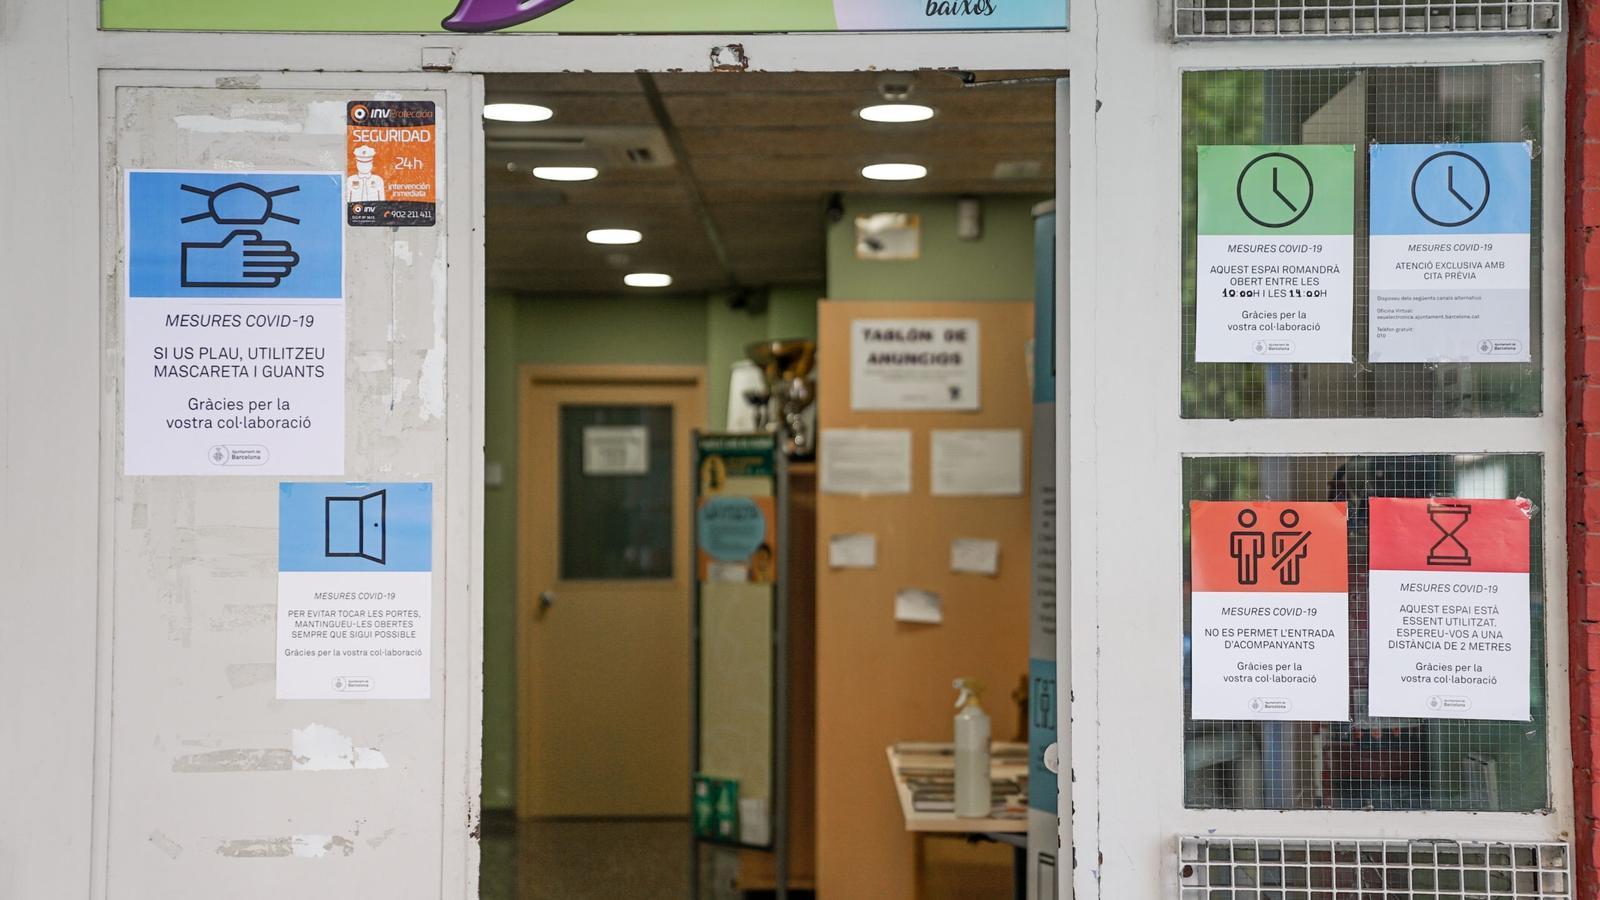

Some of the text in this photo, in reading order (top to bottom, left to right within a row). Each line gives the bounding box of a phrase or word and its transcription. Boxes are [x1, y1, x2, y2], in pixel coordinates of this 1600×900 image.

[925, 0, 996, 16] baixos
[352, 129, 431, 142] SEGURIDAD
[388, 182, 431, 190] intervención
[392, 189, 426, 197] inmediata
[391, 210, 432, 218] 902 211 411
[1227, 244, 1323, 253] MESURES COVID-19
[1408, 244, 1452, 252] MESURES
[1210, 264, 1340, 274] AQUEST ESPAI ROMANDRÀ
[1395, 261, 1505, 270] ATENCIÓ EXCLUSIVA AMB
[1423, 272, 1443, 280] CITA
[1230, 277, 1320, 286] OBERT ENTRE LES
[1268, 289, 1287, 298] LES
[1242, 310, 1307, 321] Gràcies per la
[165, 314, 314, 328] MESURES COVID-19
[1227, 323, 1257, 331] vostra
[862, 327, 968, 343] TABLÓN DE
[153, 346, 325, 361] SI US PLAU, UTILITZEU
[867, 351, 962, 366] ANUNCIOS
[154, 365, 249, 378] MASCARETA
[262, 365, 324, 378] GUANTS
[188, 397, 290, 413] Gràcies per la
[166, 417, 213, 429] vostra
[1400, 583, 1498, 594] MESURES COVID-19
[314, 592, 396, 600] MESURES COVID-19
[288, 610, 305, 618] PER
[307, 610, 336, 618] EVITAR
[338, 610, 366, 618] TOCAR
[367, 610, 383, 618] LES
[1221, 607, 1317, 617] MESURES COVID-19
[1399, 604, 1499, 615] AQUEST ESPAI ESTÀ
[294, 620, 413, 628] MANTINGUEU-LES OBERTES
[1403, 617, 1497, 627] ESSENT UTILITZAT.
[291, 630, 416, 639] SEMPRE QUE SIGUI POSSIBLE
[1205, 628, 1335, 638] NO ES PERMET L'ENTRADA
[1396, 628, 1503, 639] ESPEREU-VOS A UNA
[1224, 640, 1315, 650] D'ACOMPANYANTS
[1388, 640, 1512, 652] DISTÀNCIA DE 2 METRES
[284, 648, 316, 657] Gràcies
[317, 650, 332, 658] per
[1237, 661, 1302, 673] Gràcies per la
[1415, 662, 1482, 674] Gràcies per la
[1223, 675, 1253, 683] vostra
[1401, 675, 1431, 683] vostra
